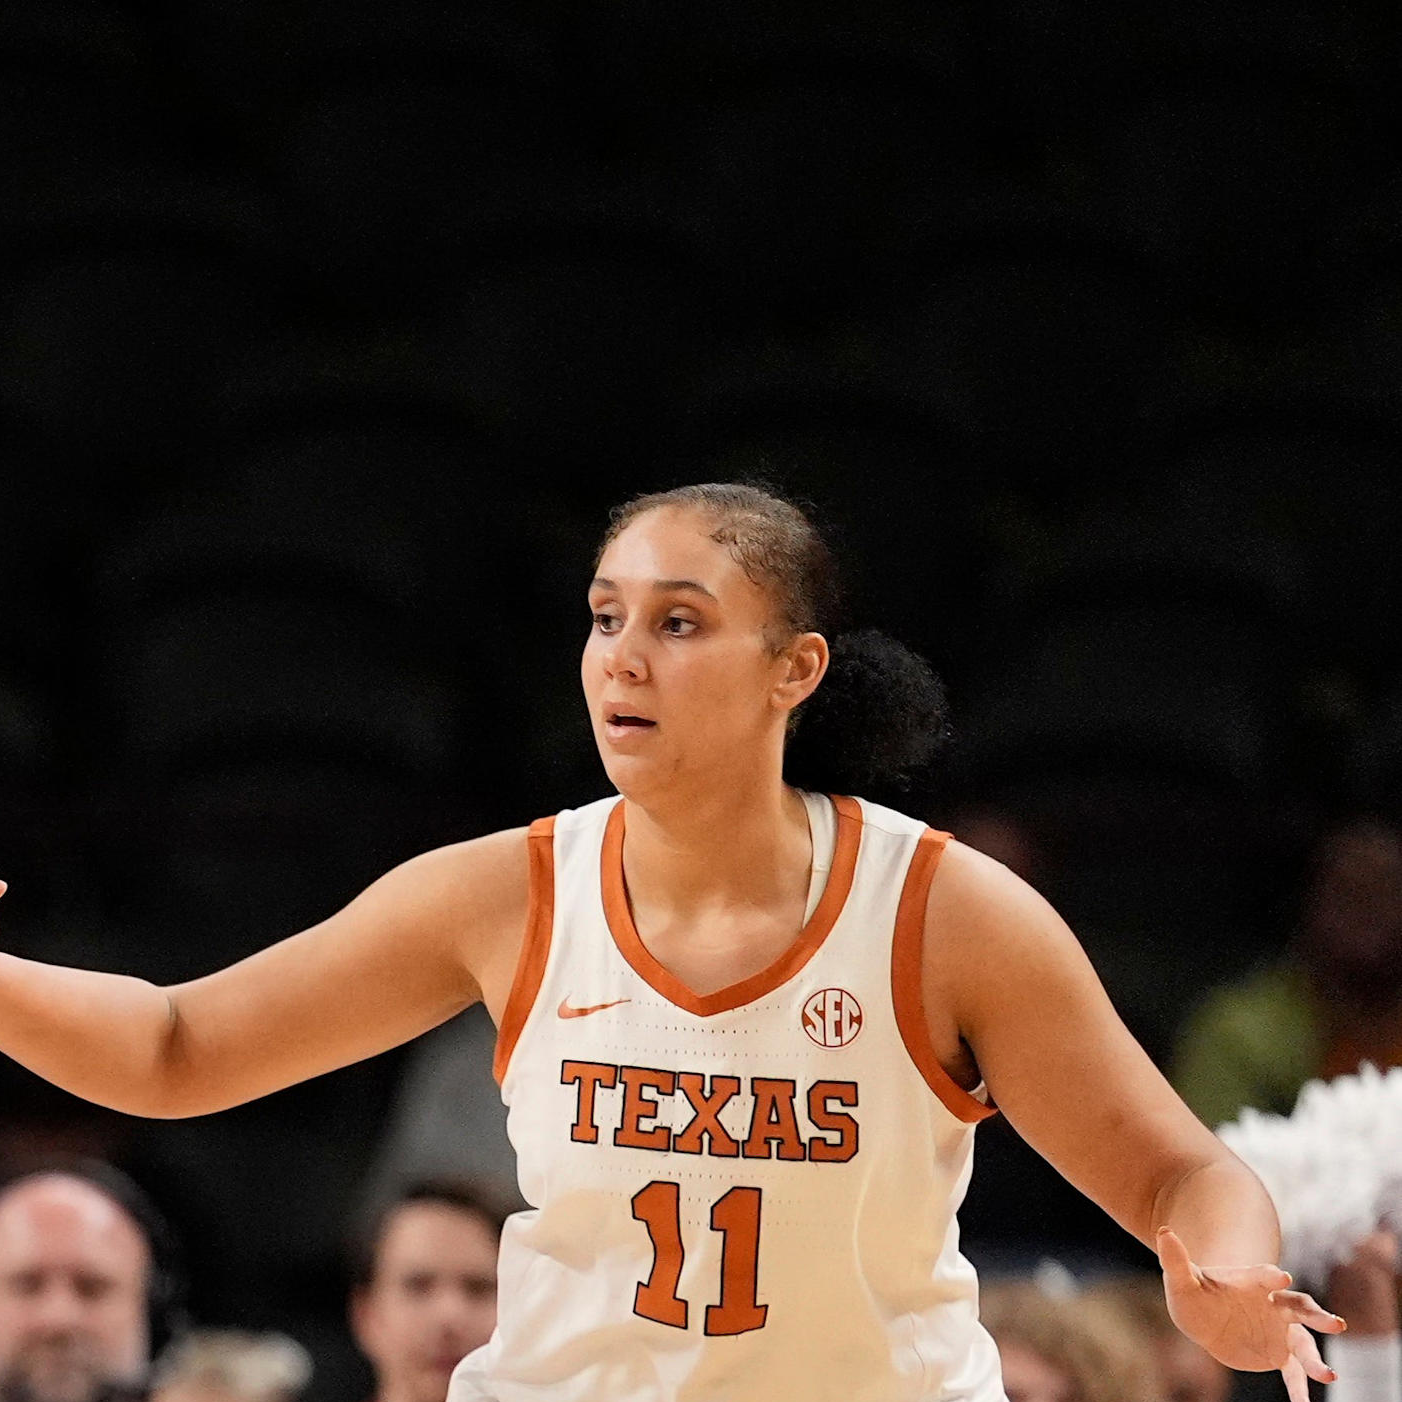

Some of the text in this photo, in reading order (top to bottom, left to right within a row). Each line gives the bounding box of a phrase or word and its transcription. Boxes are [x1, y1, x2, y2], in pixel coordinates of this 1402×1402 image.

[802, 988, 862, 1049] SEC
[561, 1060, 859, 1163] TEXAS
[631, 1181, 769, 1336] 11
